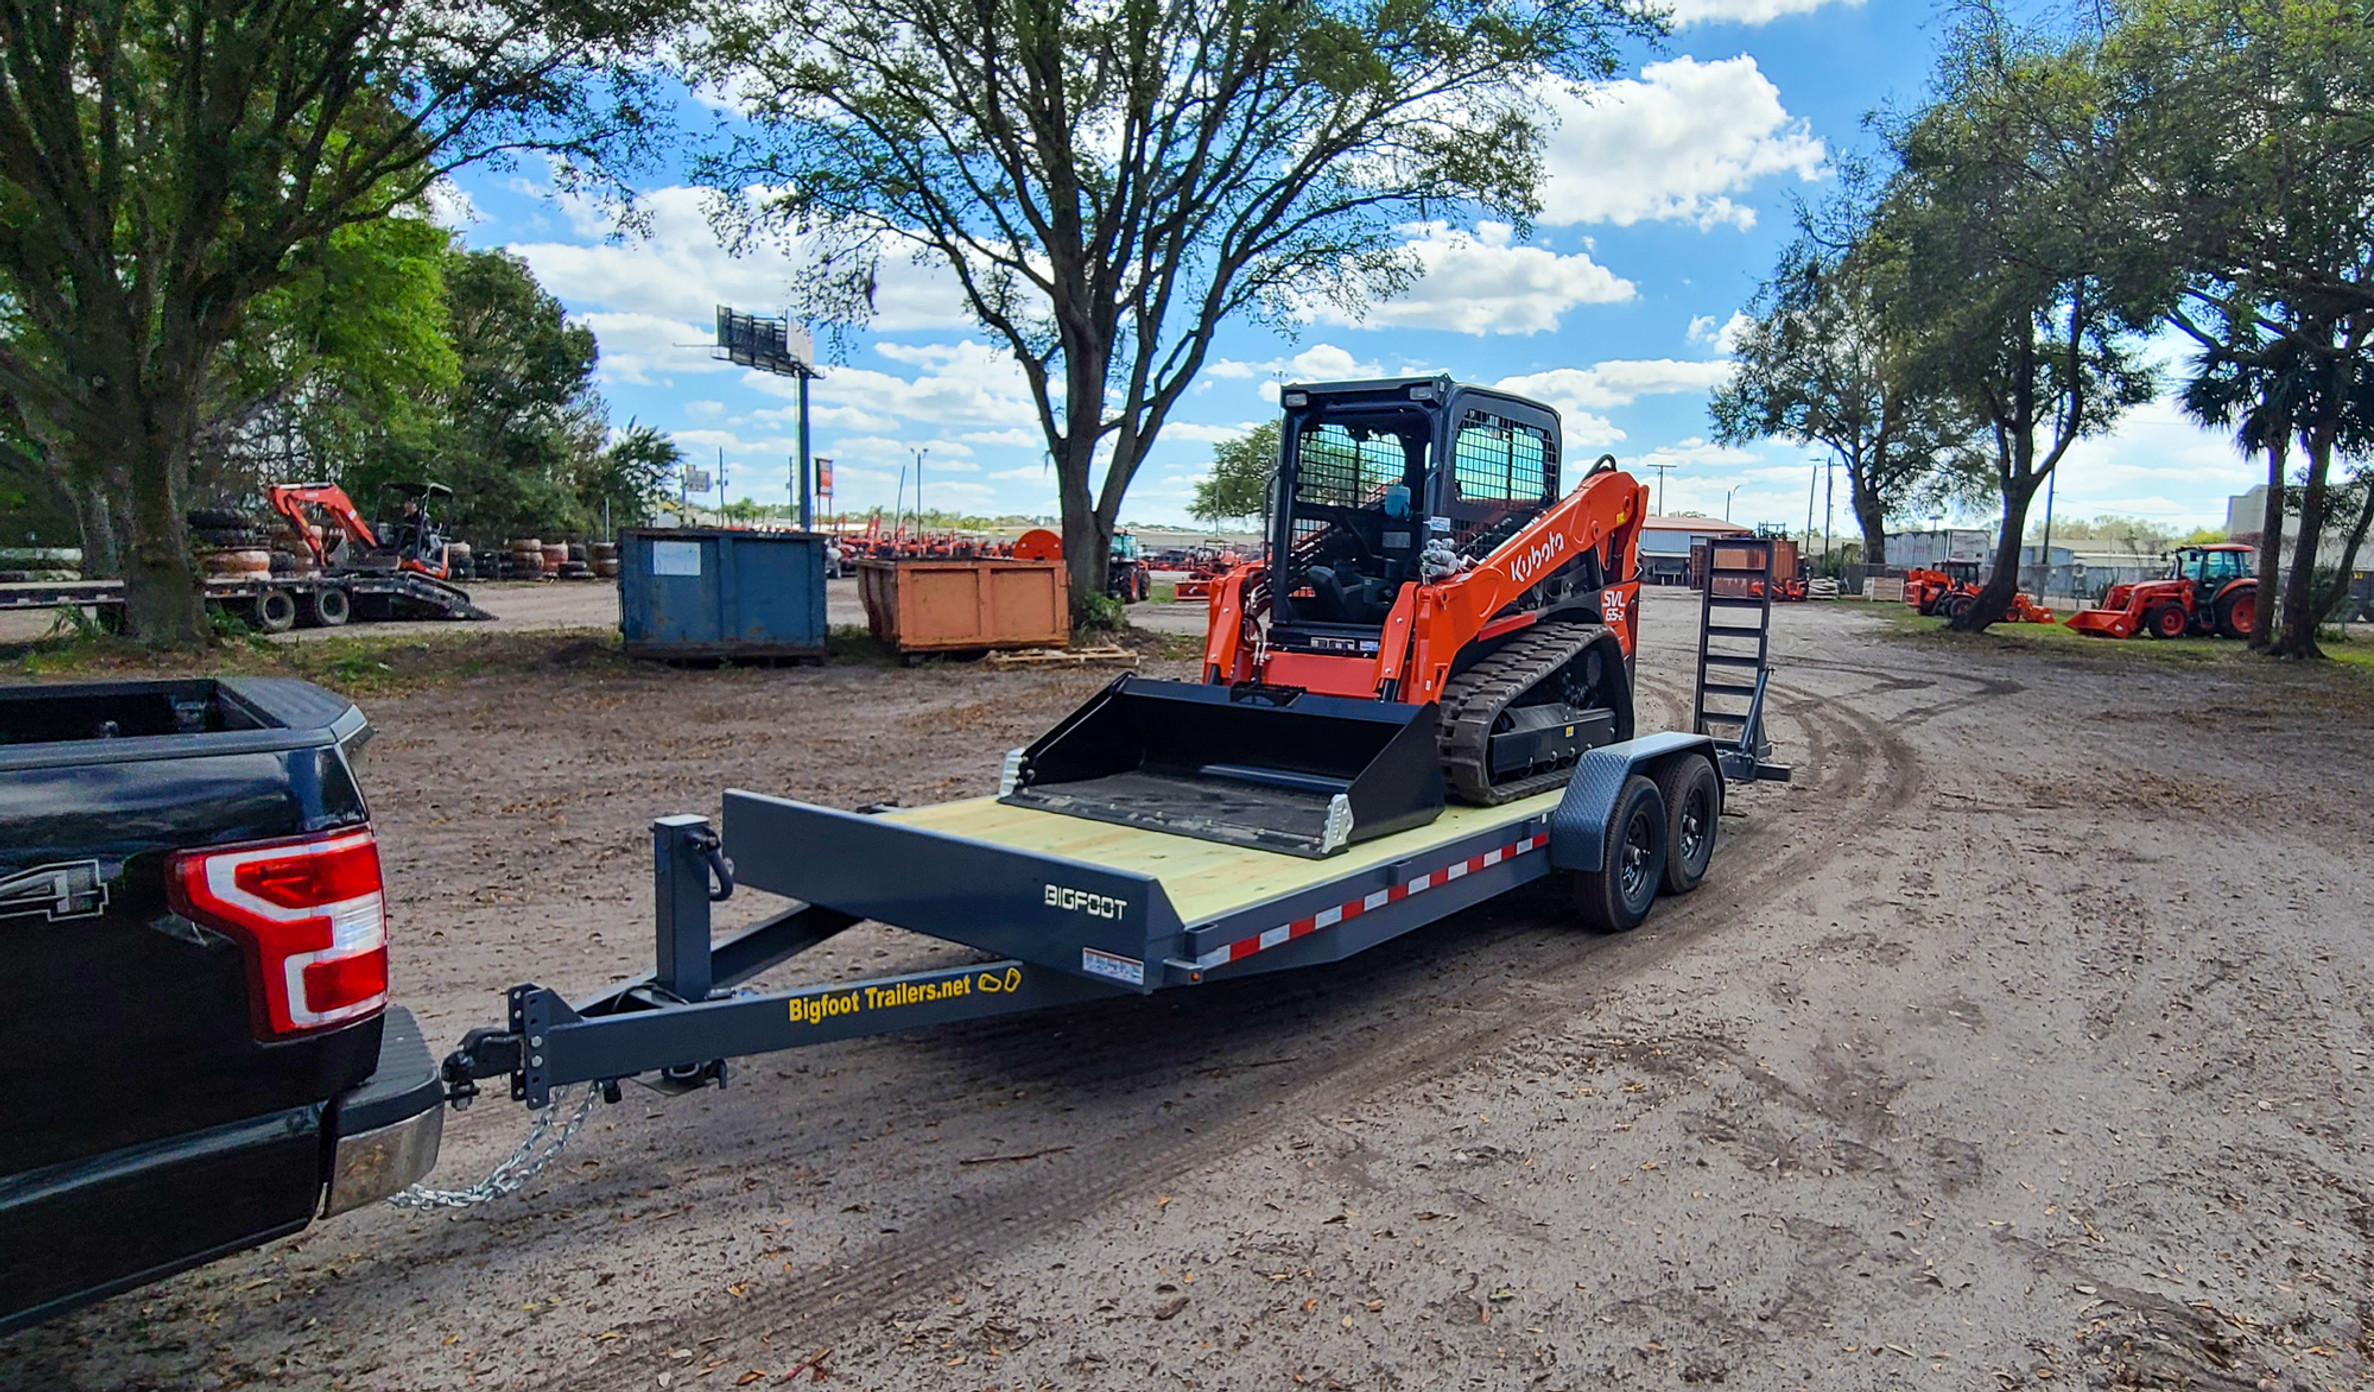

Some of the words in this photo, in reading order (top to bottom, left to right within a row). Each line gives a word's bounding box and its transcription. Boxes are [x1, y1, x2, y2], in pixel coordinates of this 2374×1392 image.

[1510, 531, 1564, 582] Kubota
[1602, 590, 1626, 607] SVL
[1605, 608, 1625, 622] 65-2
[1044, 884, 1128, 921] BIGFOOT
[789, 990, 860, 1025] Bigfoot
[864, 974, 972, 1010] Trailers.net
